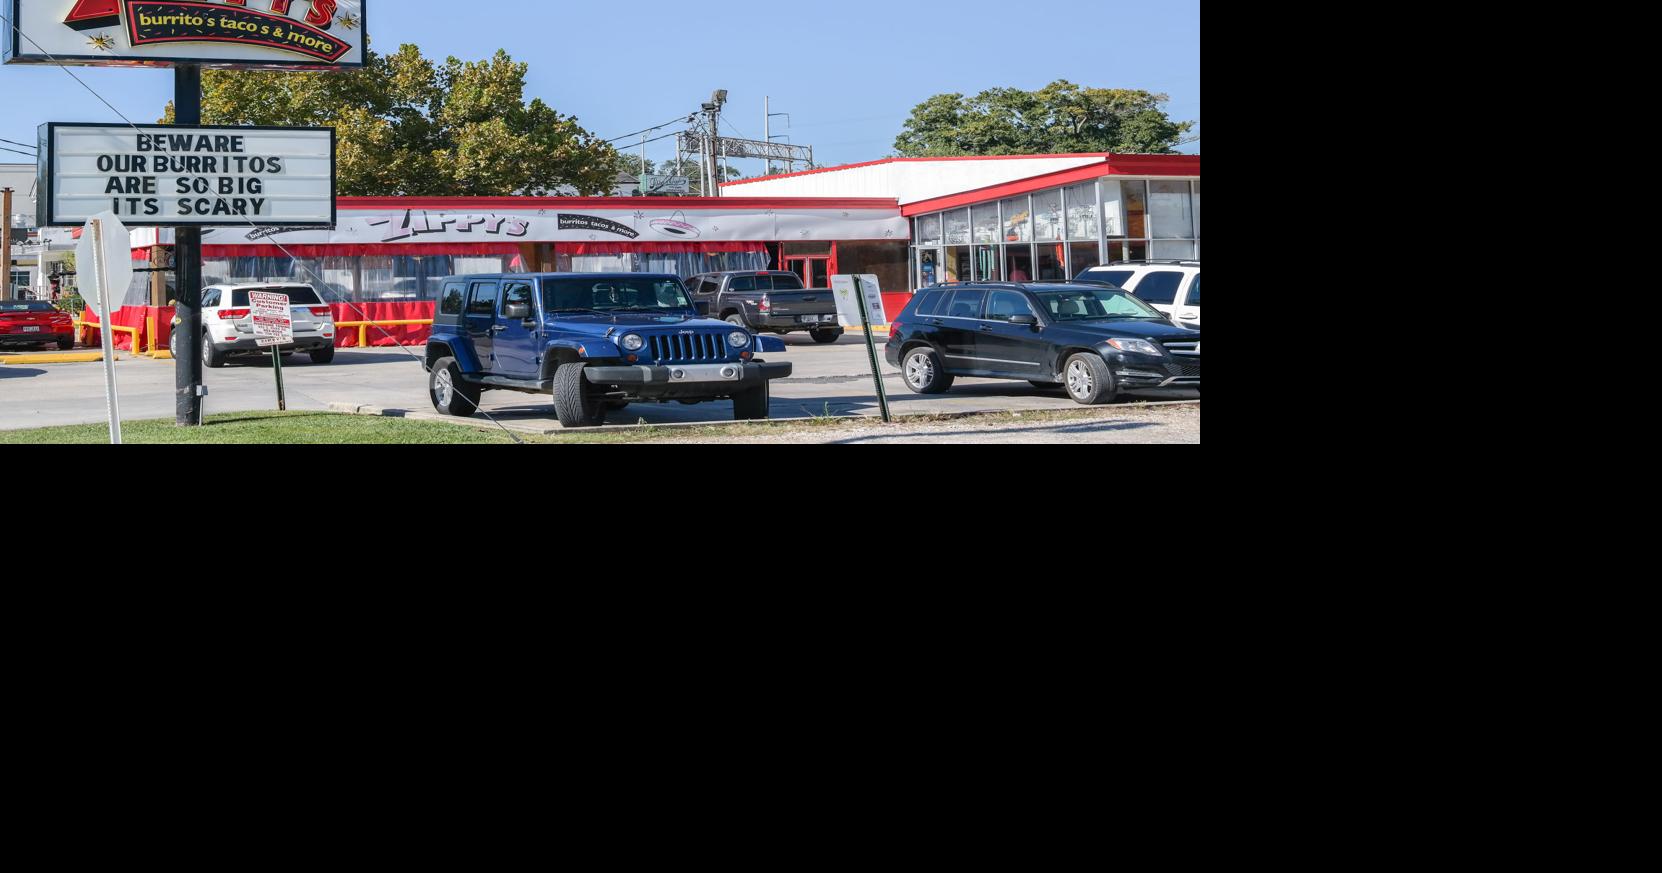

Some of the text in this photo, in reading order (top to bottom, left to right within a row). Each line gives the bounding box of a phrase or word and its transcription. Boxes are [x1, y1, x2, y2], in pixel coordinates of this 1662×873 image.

[272, 27, 284, 38] &
[287, 31, 333, 53] more
[136, 134, 244, 152] BEWARE
[97, 154, 282, 173] OUR BURRITOS
[104, 176, 262, 194] ARE SO BIG
[113, 197, 265, 215] ITS SCARY
[248, 226, 280, 239] burritos
[591, 221, 609, 229] tacos
[616, 227, 635, 236] more
[250, 291, 288, 302] WARNING!
[251, 298, 288, 306] Customer
[256, 303, 284, 311] Parking
